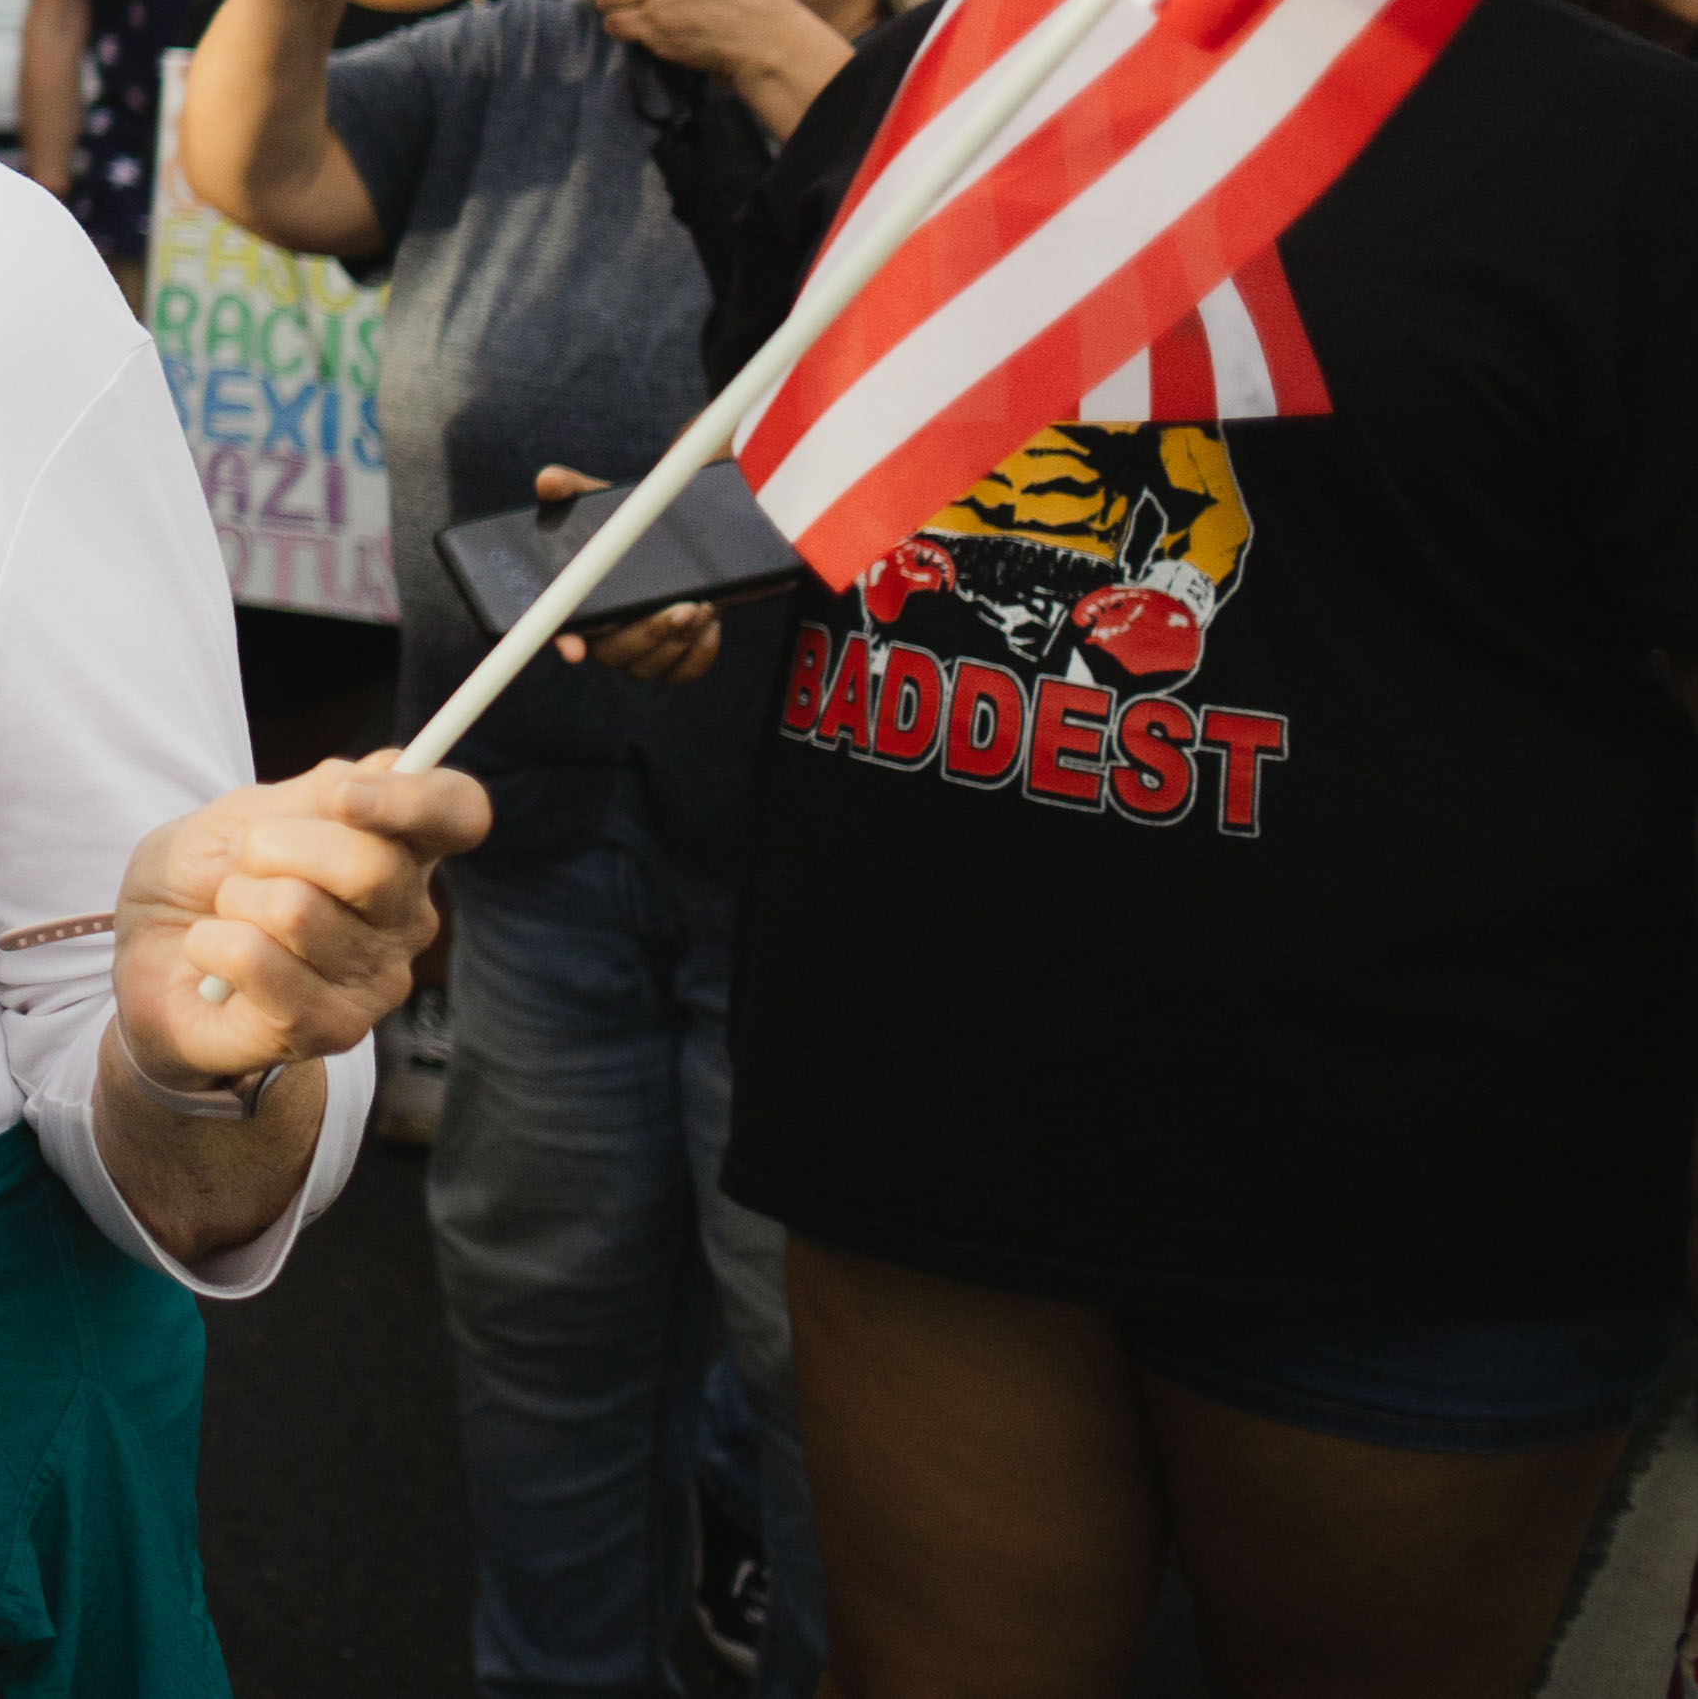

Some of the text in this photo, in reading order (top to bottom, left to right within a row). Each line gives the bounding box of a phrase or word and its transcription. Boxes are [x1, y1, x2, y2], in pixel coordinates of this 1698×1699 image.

[155, 285, 383, 397] RACIS
[204, 445, 346, 533] AZI
[780, 621, 1290, 838] BADDEST
